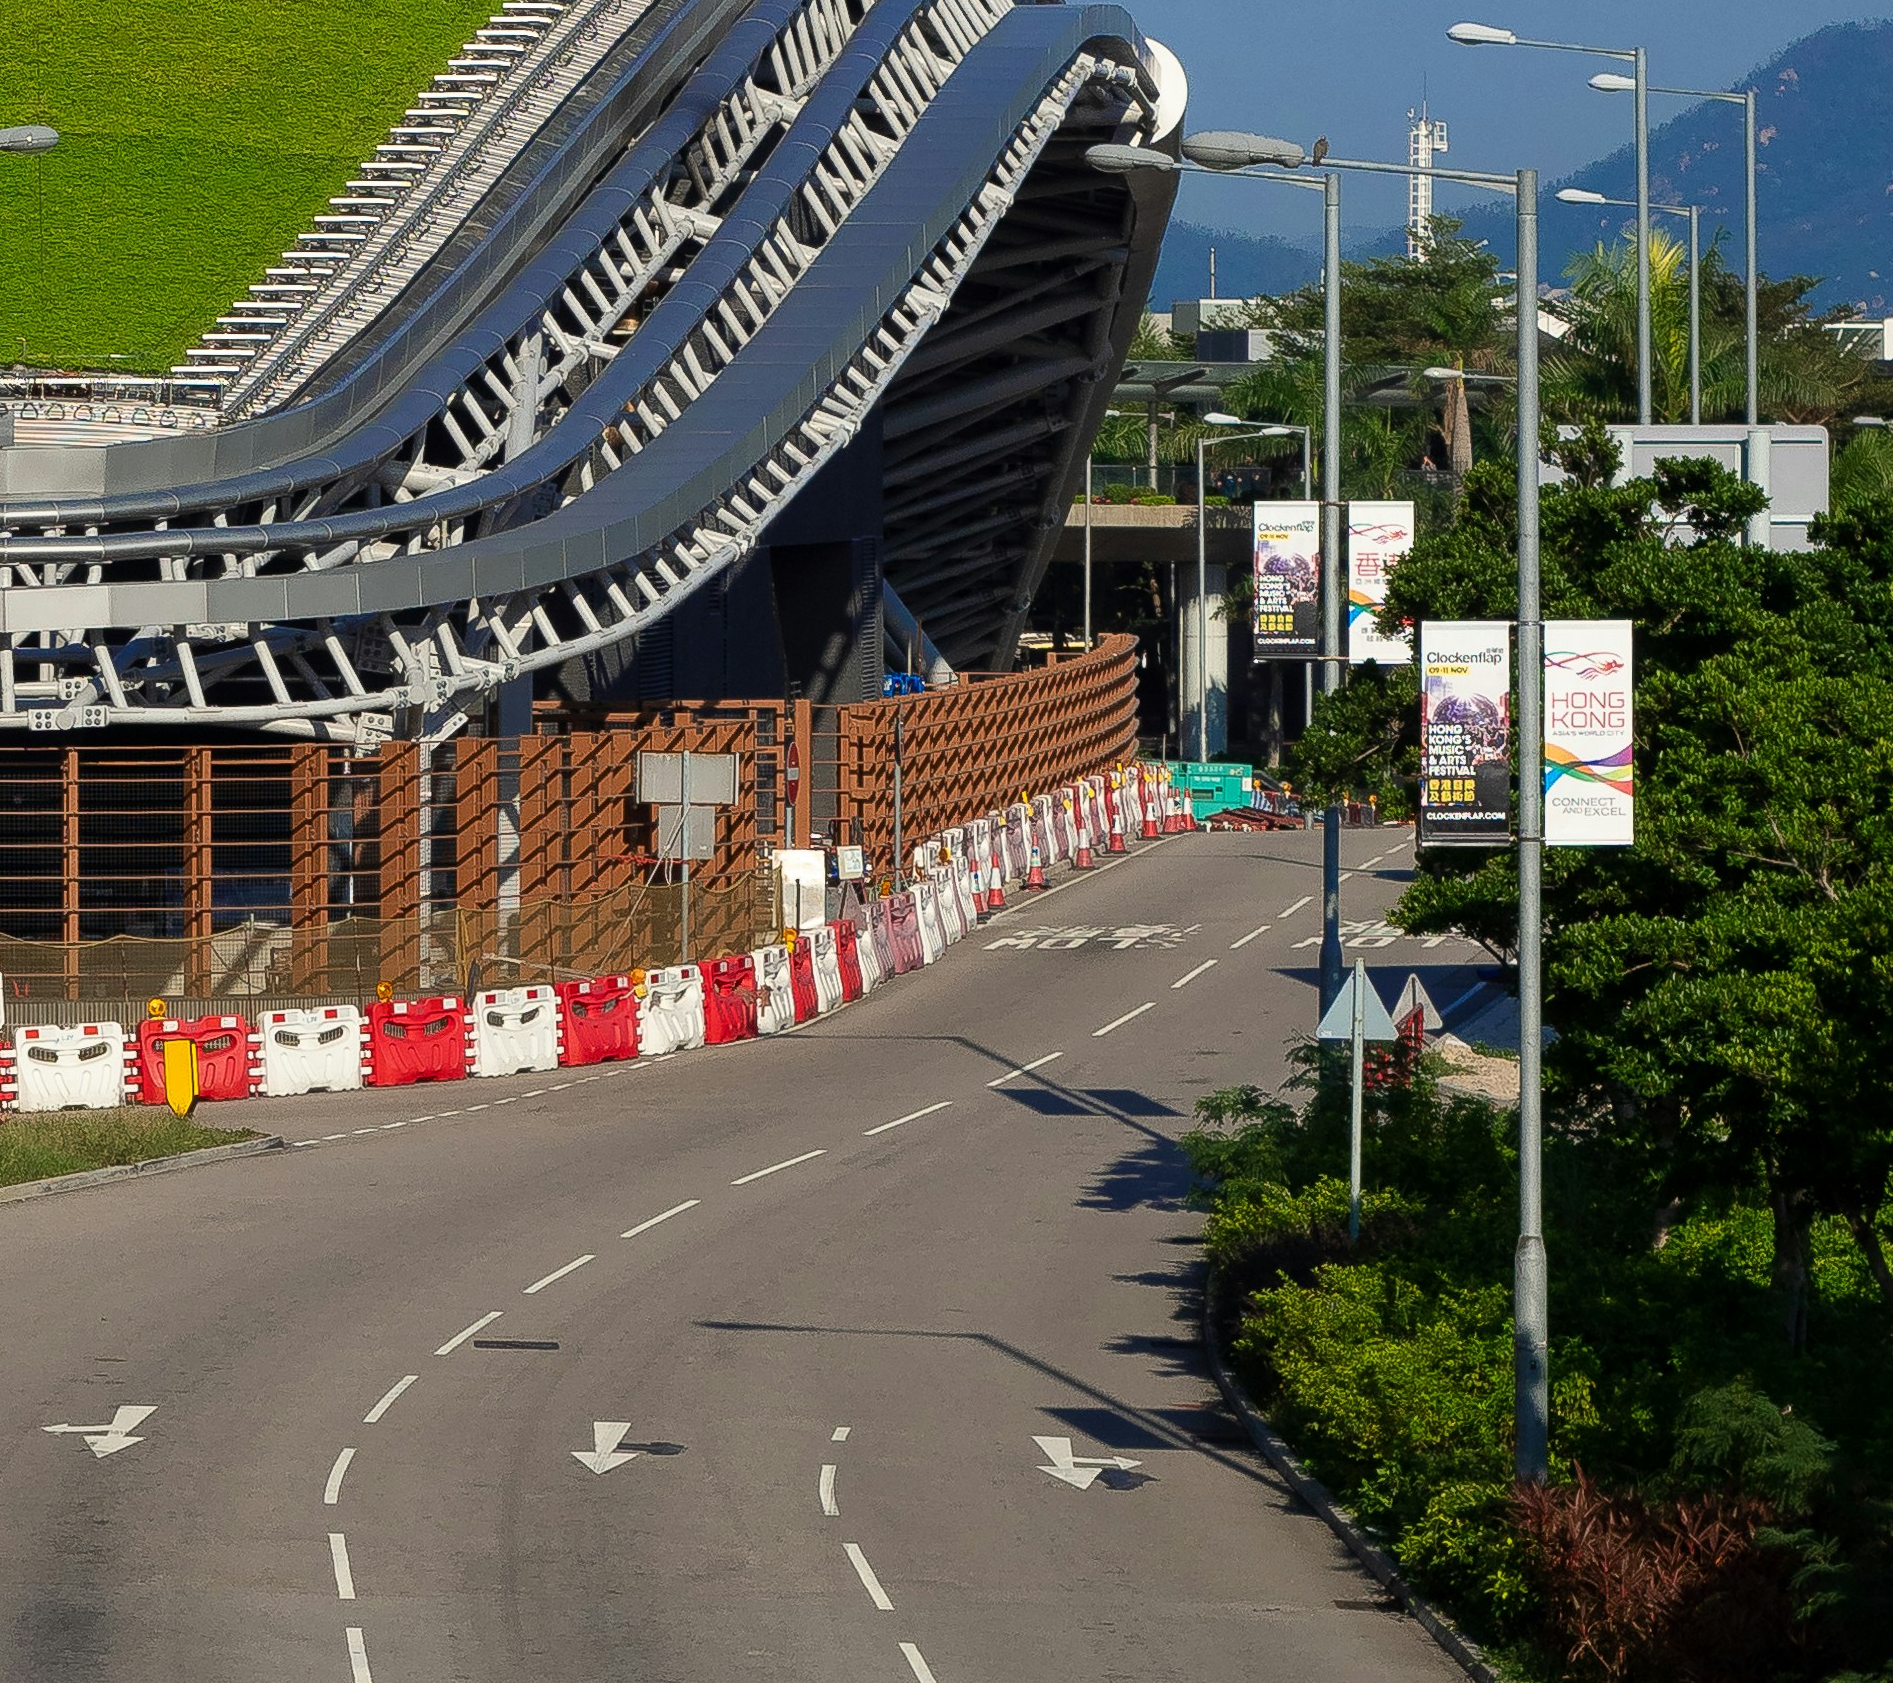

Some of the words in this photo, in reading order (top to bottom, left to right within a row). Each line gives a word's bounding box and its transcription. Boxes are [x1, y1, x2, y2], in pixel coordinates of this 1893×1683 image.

[1426, 652, 1502, 666] Clockenflap
[1551, 692, 1625, 709] HONG
[1551, 711, 1625, 729] KONG
[1428, 724, 1463, 734] HONG
[1428, 734, 1472, 745] KONG'S
[1428, 745, 1465, 755] MUSIC
[1428, 755, 1437, 765] &
[1439, 755, 1467, 765] ARTS
[1428, 766, 1476, 776] FESTIVAL
[1551, 797, 1616, 806] CONNECT
[1426, 812, 1506, 820] CLOCKENFLAP.COM
[1584, 807, 1627, 816] EXCEL
